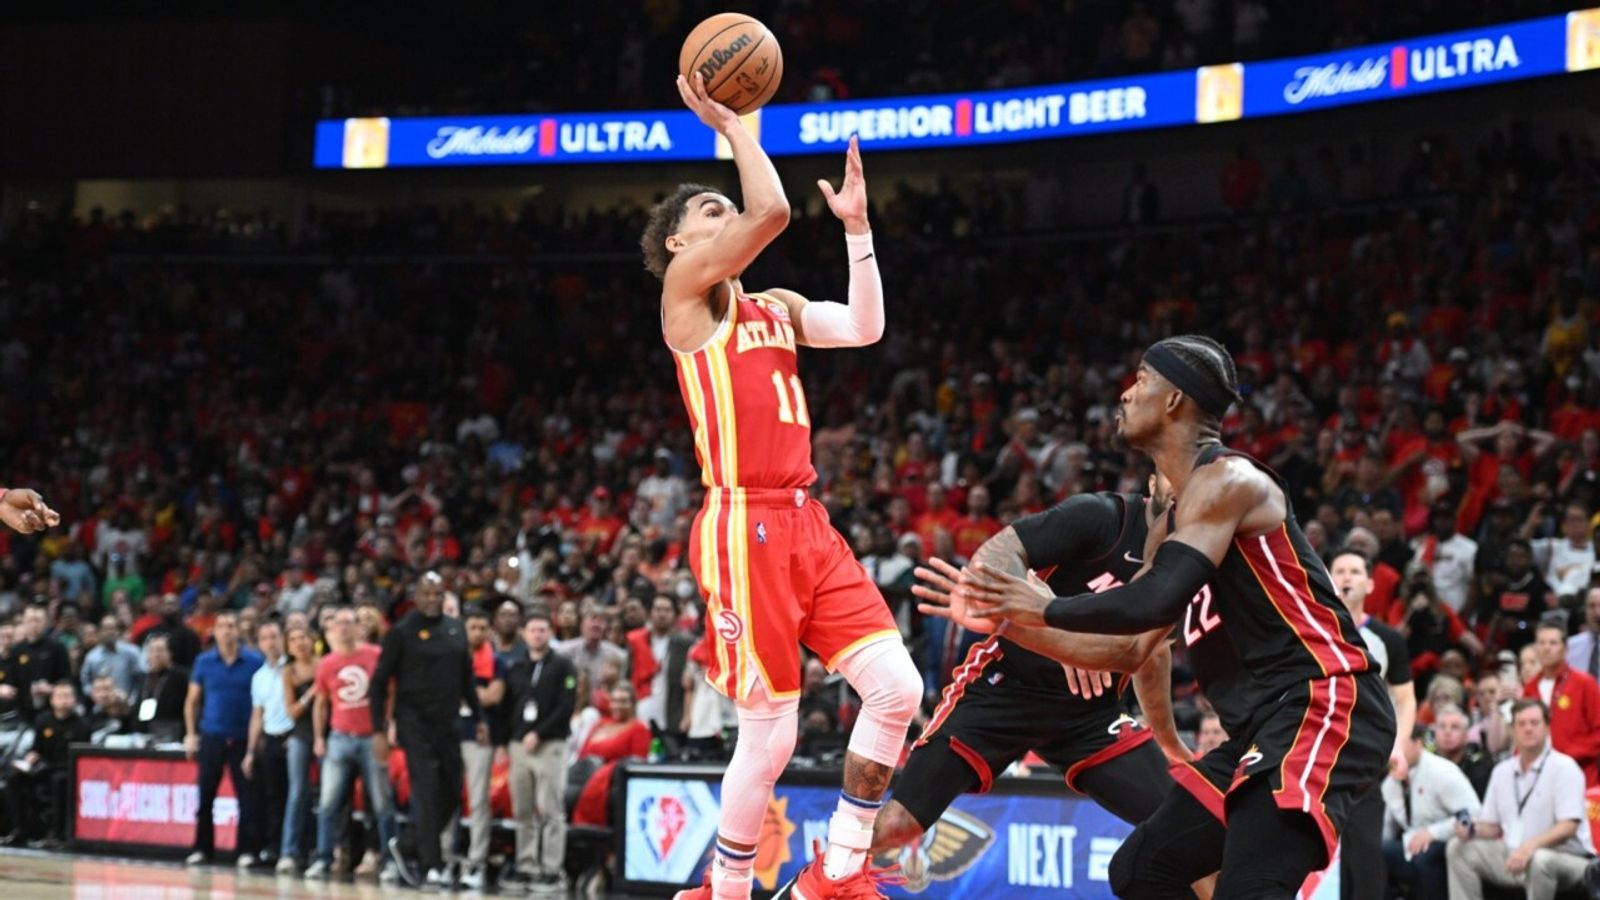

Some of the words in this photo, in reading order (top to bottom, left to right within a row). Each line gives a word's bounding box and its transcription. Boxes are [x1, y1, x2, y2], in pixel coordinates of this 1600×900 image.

[1410, 35, 1521, 83] ULTRA
[560, 120, 674, 153] ULTRA
[799, 105, 952, 143] SUPERIOR
[974, 93, 1066, 134] LIGHT
[1068, 86, 1147, 125] BEER
[771, 369, 810, 429] 11
[1007, 822, 1078, 889] NEXT
